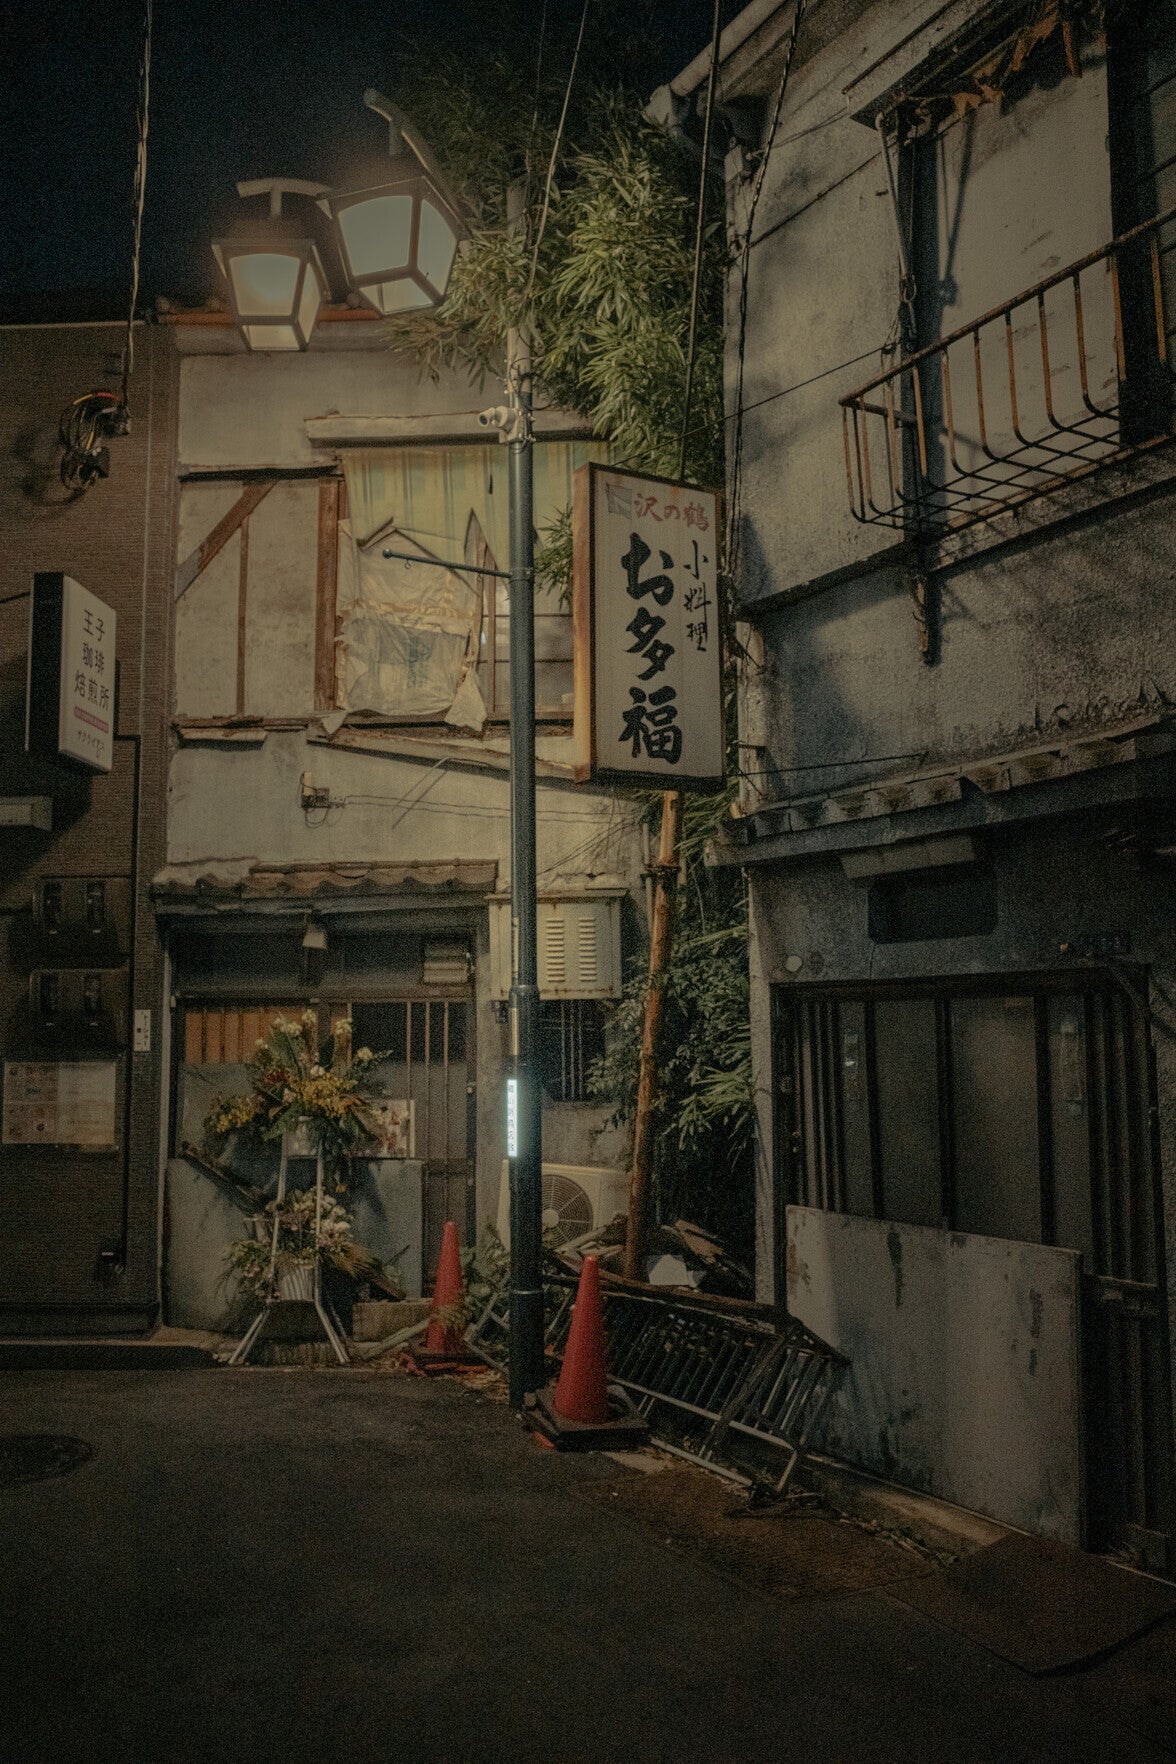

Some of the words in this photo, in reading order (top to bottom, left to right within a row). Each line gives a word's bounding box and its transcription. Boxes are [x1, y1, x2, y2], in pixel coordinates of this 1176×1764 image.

[634, 493, 710, 531] 沢の鶴
[83, 609, 105, 642] 王子
[683, 539, 712, 652] 小料理
[618, 532, 683, 765] お多福
